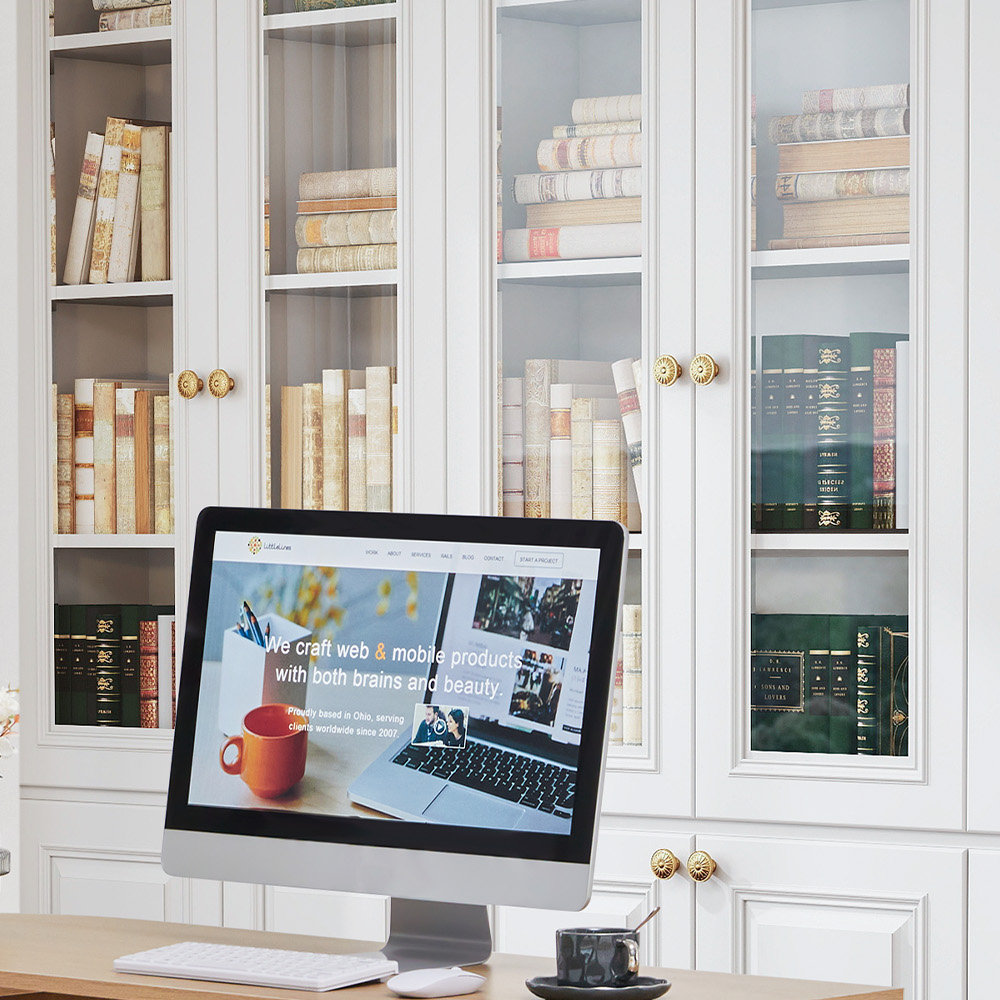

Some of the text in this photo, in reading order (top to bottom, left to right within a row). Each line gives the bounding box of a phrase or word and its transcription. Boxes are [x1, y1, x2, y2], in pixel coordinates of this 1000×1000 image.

[265, 635, 523, 669] We craft web & mobile products
[275, 664, 504, 700] with both brains and beauty.
[287, 706, 404, 725] Proudly based in Ohio, serving
[288, 722, 314, 732] clients
[315, 724, 354, 735] worldwide
[356, 726, 376, 737] since
